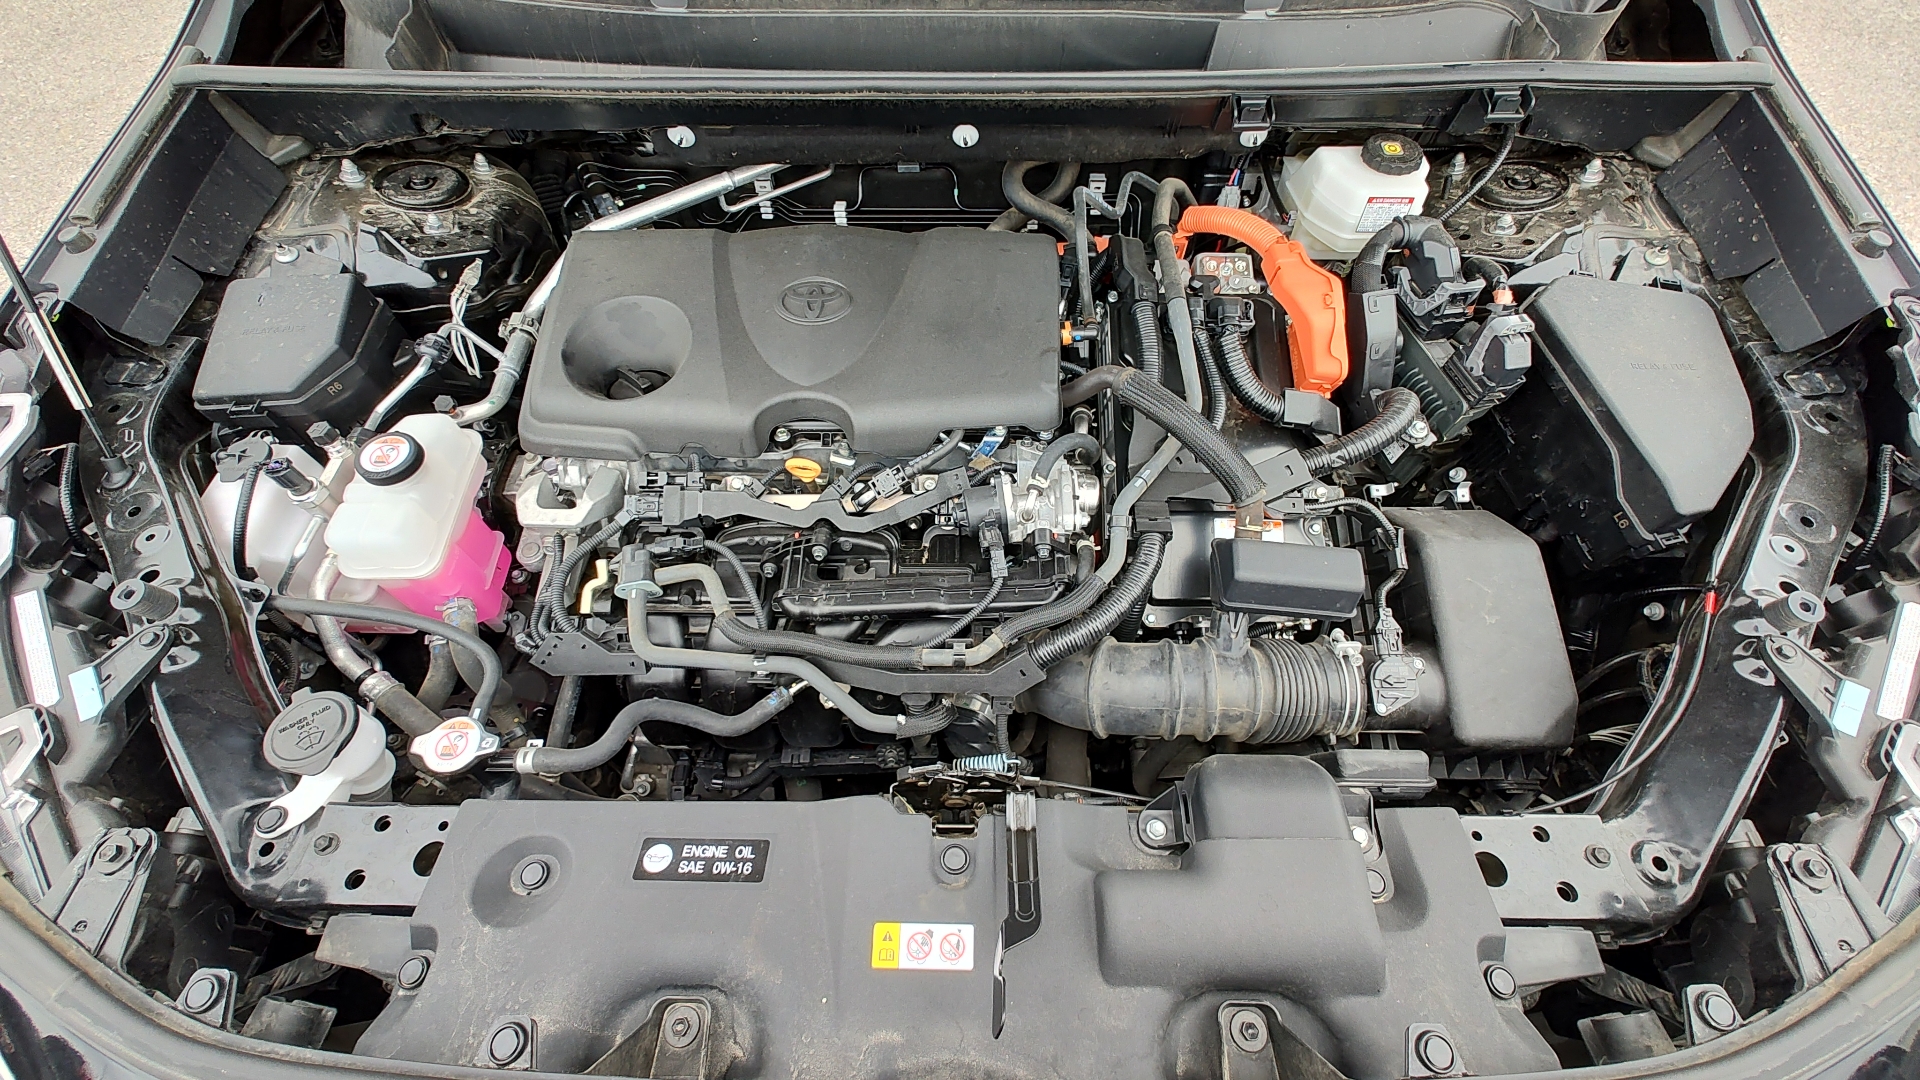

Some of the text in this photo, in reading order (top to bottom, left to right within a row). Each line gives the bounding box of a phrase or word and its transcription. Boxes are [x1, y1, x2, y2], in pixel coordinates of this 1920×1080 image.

[1630, 362, 1661, 371] RELAY
[326, 381, 343, 396] R6
[1613, 511, 1629, 529] L6
[279, 705, 332, 734] WASHER FLUID
[297, 718, 315, 731] ONLY
[682, 844, 756, 859] ENGINE OIL
[677, 861, 753, 876] SAE 0W-16
